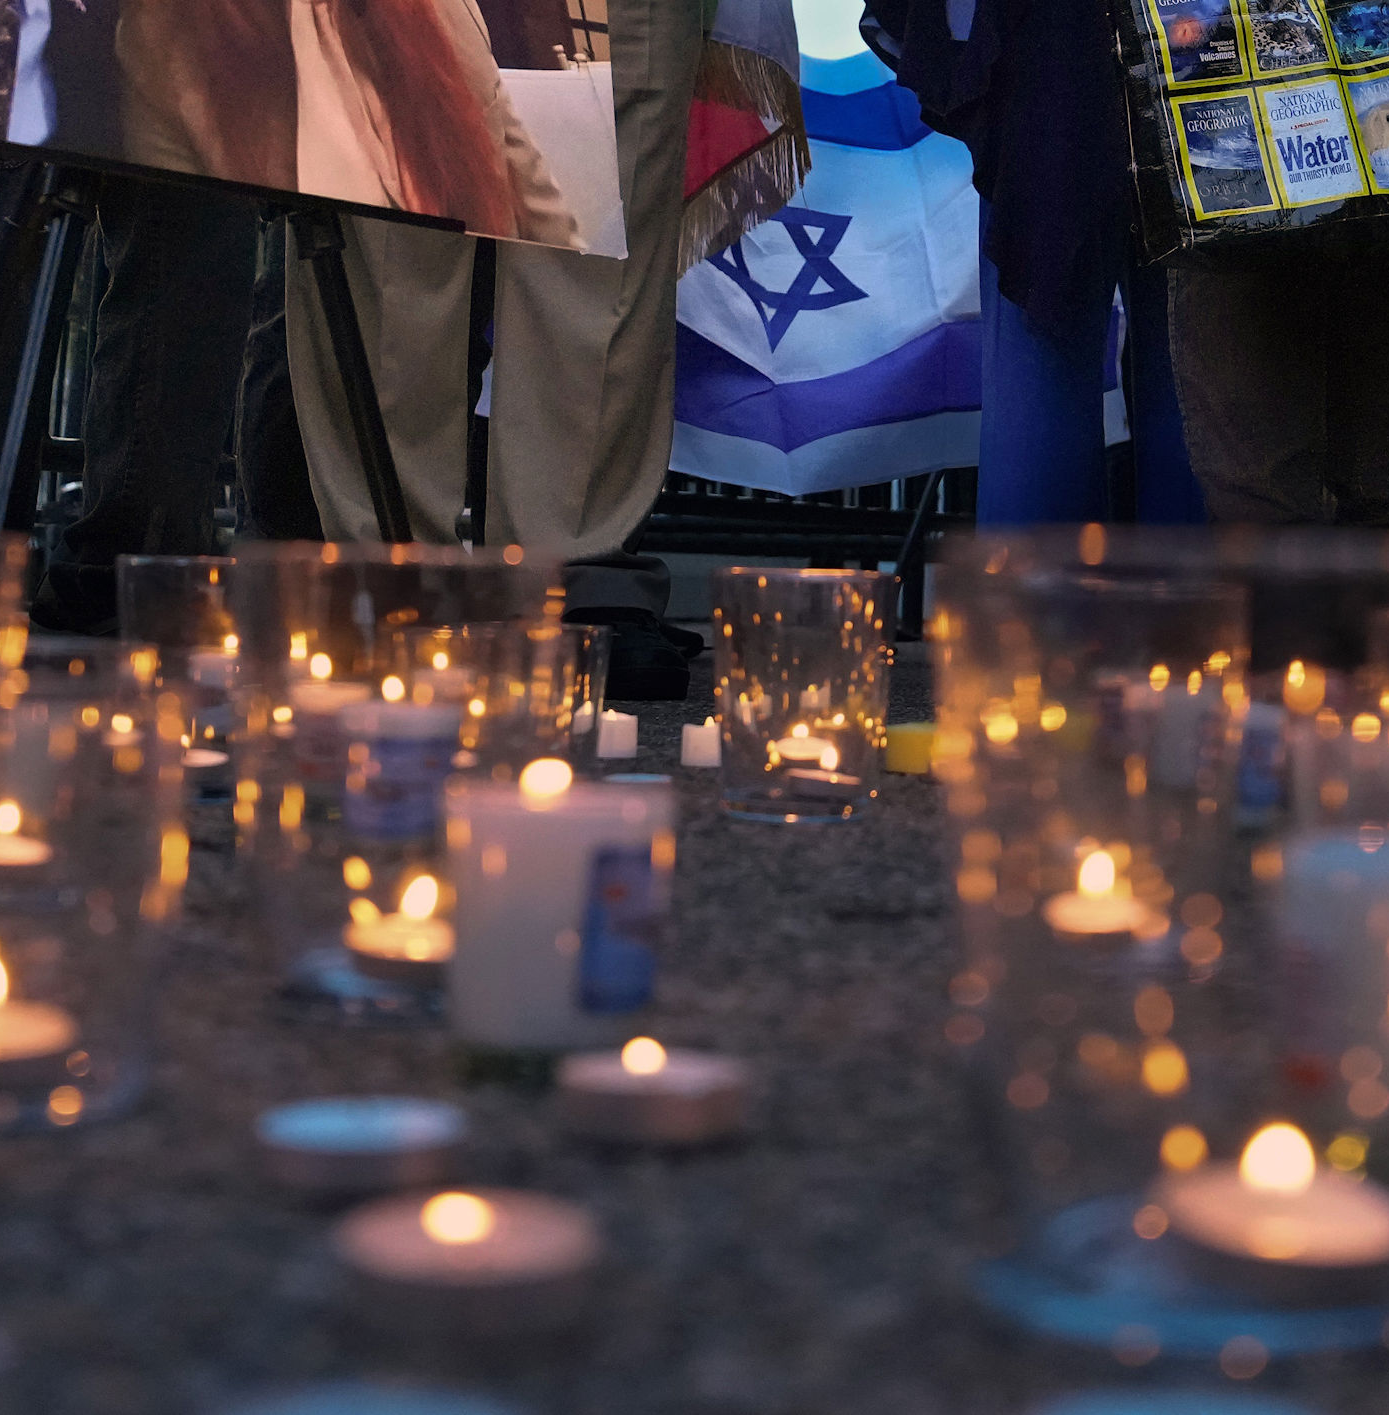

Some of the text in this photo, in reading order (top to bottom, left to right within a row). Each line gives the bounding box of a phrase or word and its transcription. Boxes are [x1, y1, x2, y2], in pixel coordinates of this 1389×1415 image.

[1199, 51, 1236, 63] Volcanoes
[1278, 89, 1330, 107] NATIONAL
[1196, 107, 1237, 120] NATIONAL
[1270, 97, 1341, 122] GEOGRAPHIC
[1187, 114, 1249, 133] GEOGRAPHIC
[1276, 134, 1349, 173] Water
[1289, 163, 1352, 184] OUR THIRSTY WORLD
